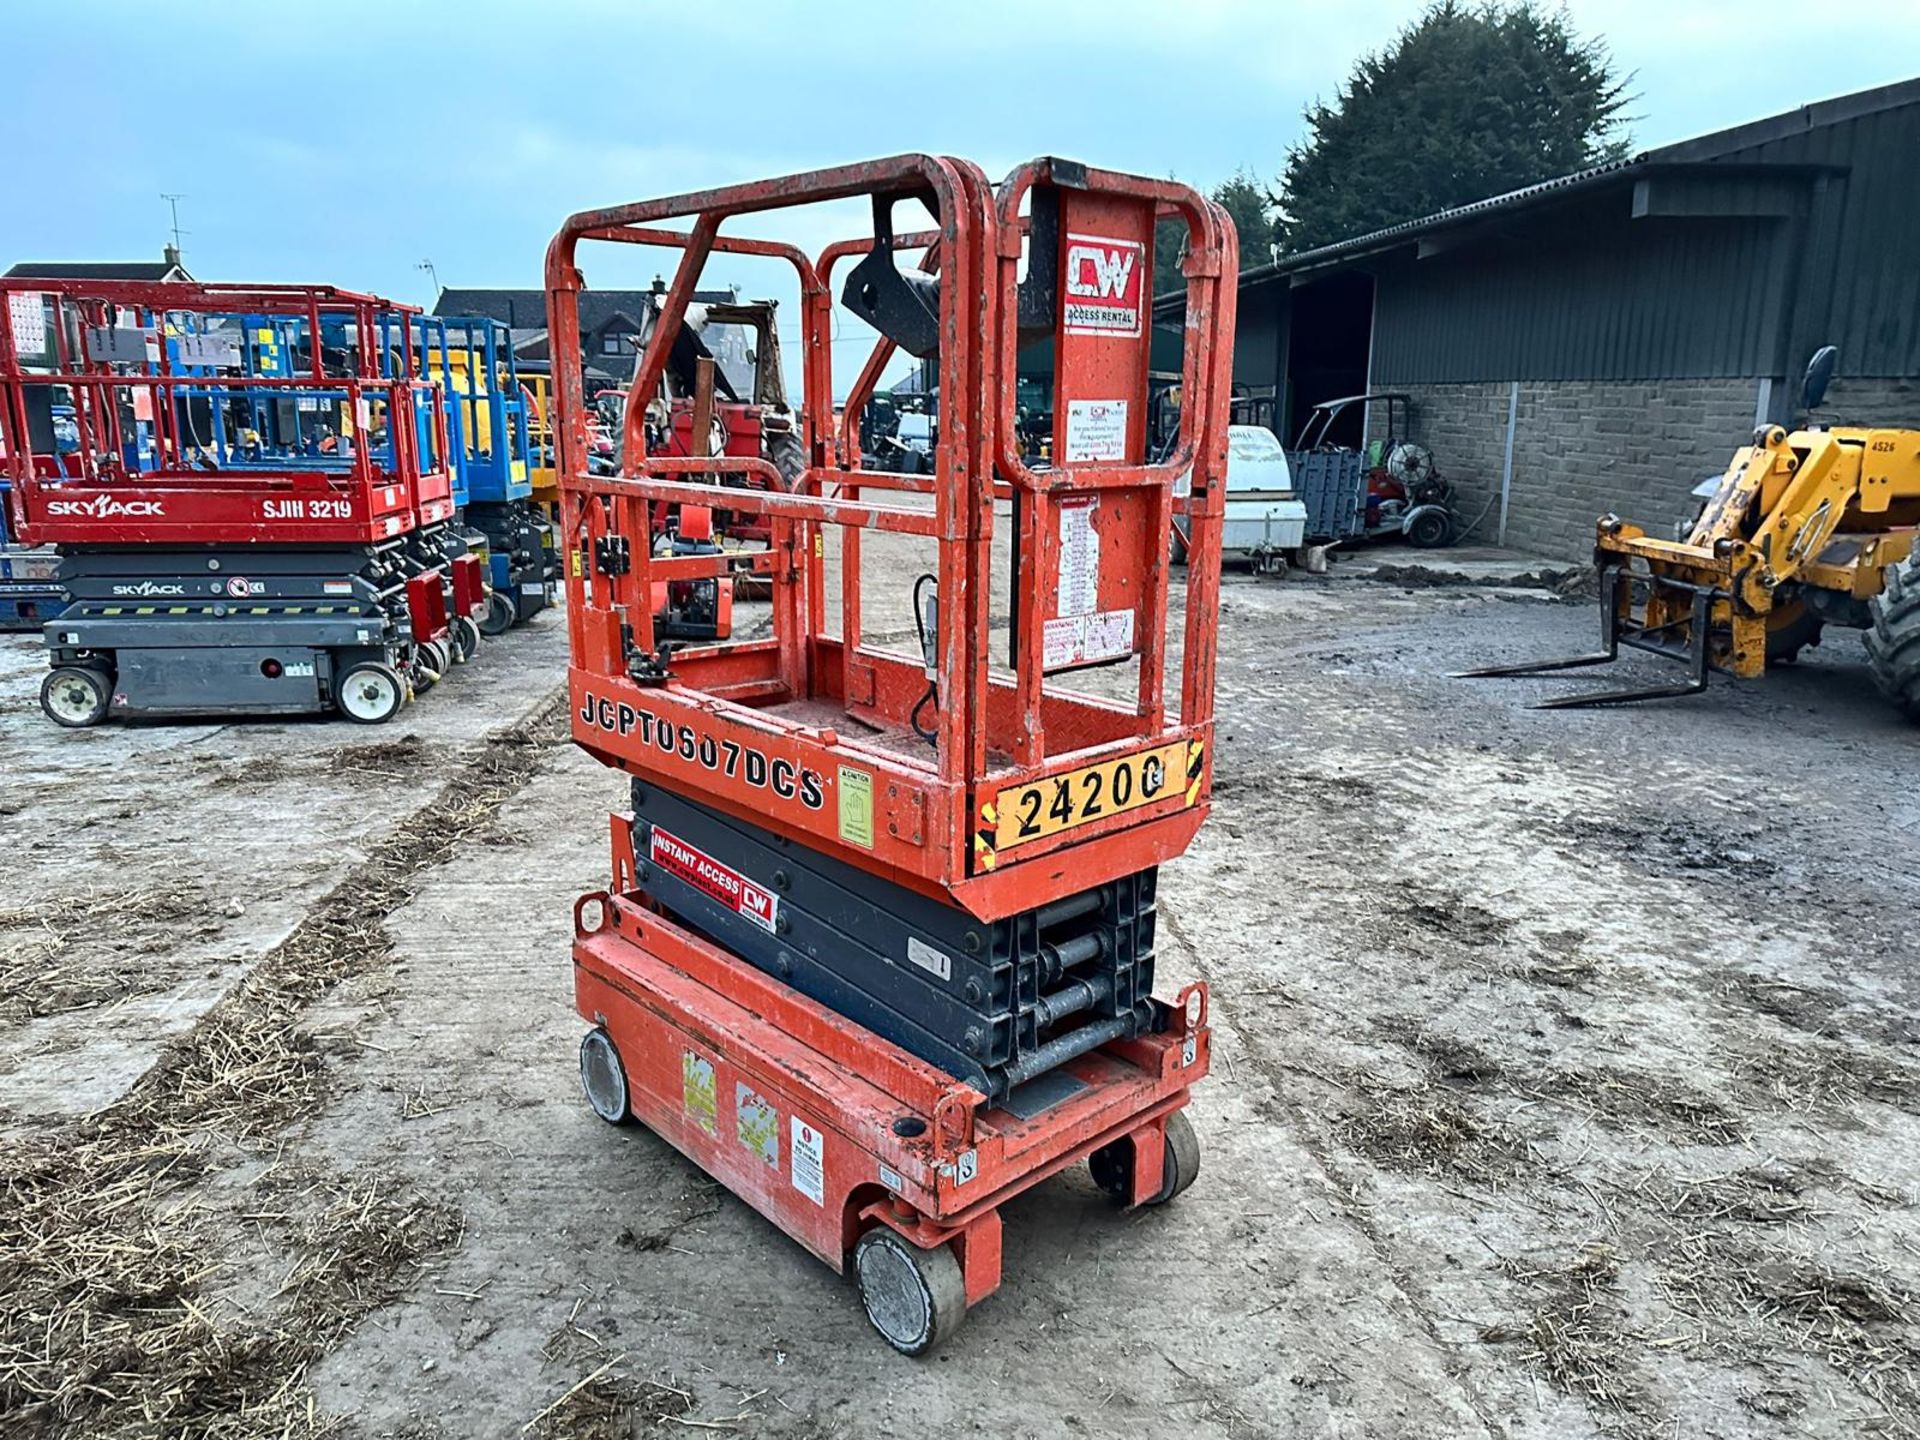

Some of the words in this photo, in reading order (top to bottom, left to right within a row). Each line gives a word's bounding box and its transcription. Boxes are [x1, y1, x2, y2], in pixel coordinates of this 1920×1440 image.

[1067, 245, 1135, 299] CW
[1068, 308, 1100, 321] ACCESS
[1102, 310, 1132, 323] RENTAL
[1872, 441, 1896, 452] 4526
[47, 494, 166, 519] SKYJACK
[309, 500, 352, 519] 3219
[112, 580, 186, 596] SKYJACK
[654, 833, 696, 868] INSTANT
[696, 860, 740, 895] ACCESS
[743, 886, 767, 914] CW
